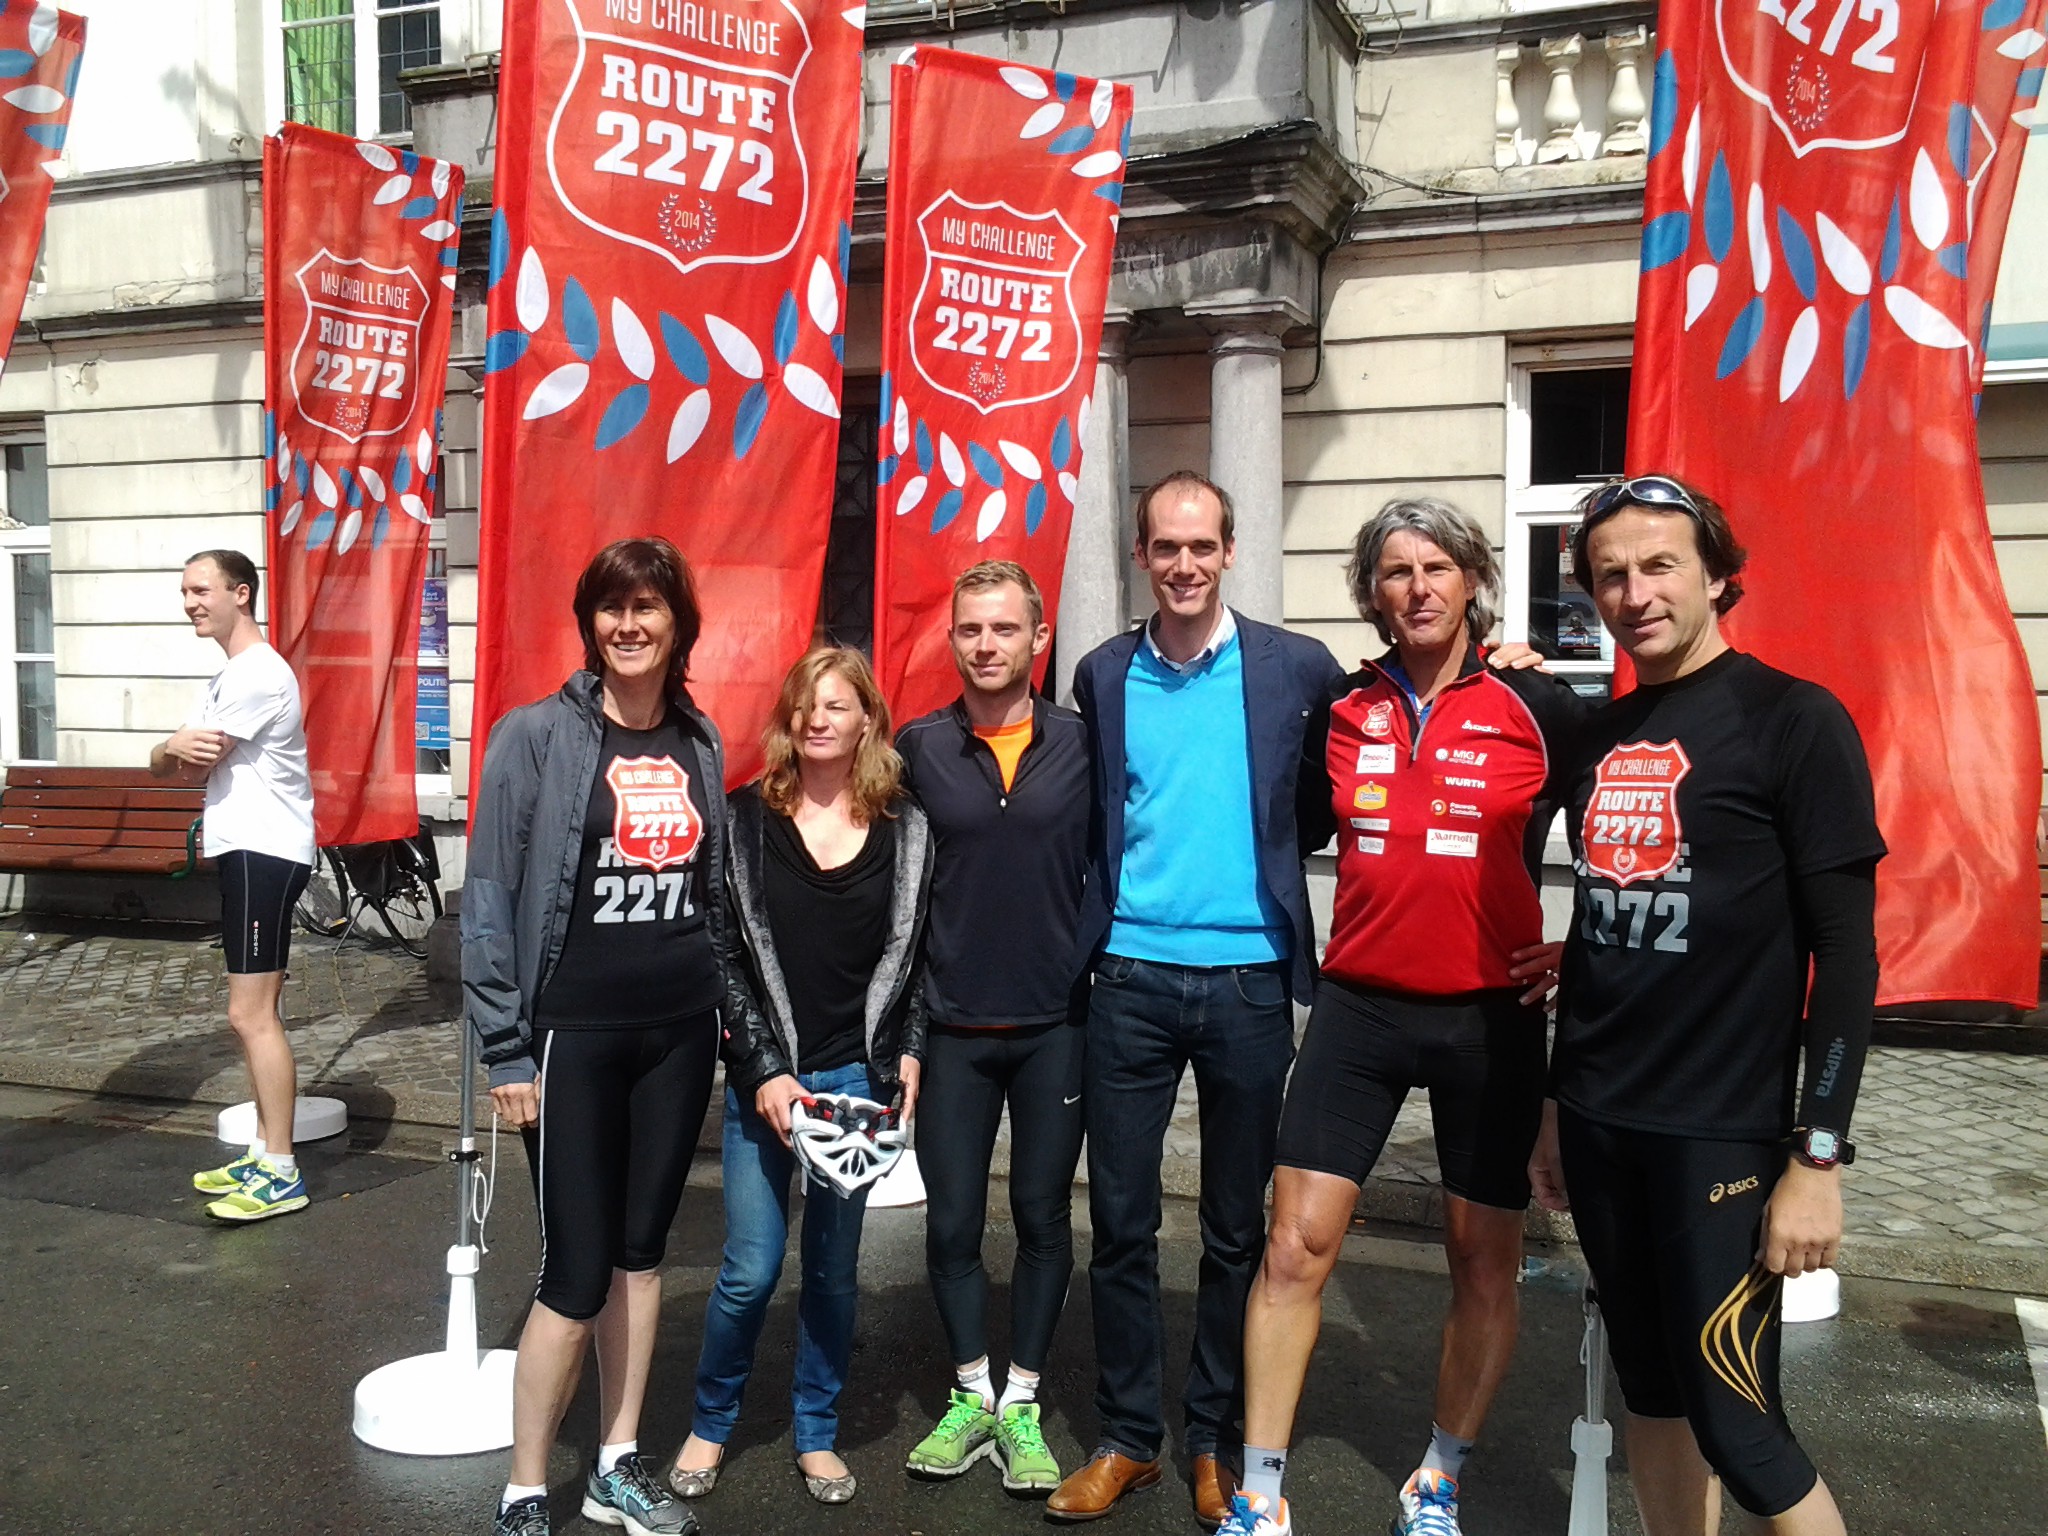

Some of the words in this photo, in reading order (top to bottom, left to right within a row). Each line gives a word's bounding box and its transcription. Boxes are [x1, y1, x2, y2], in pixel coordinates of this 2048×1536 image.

[606, 0, 642, 24] MY
[651, 0, 780, 56] CHALLENGE
[601, 54, 776, 134] ROUTE
[1795, 76, 1816, 104] 2014
[593, 110, 774, 206] 2272
[674, 210, 700, 230] 2014
[942, 217, 966, 246] MY
[971, 222, 1056, 261] CHALLENGE
[321, 271, 340, 296] MY
[341, 276, 411, 310] CHALLENGE
[940, 267, 1052, 314] ROUTE
[318, 316, 408, 357] ROUTE
[932, 305, 1052, 362] 2272
[311, 350, 405, 400] 2272
[978, 371, 996, 385] 2014
[345, 406, 362, 418] 2014
[1621, 759, 1672, 776] CHALLENGE
[624, 795, 684, 812] ROUTE
[1597, 790, 1665, 813] ROUTE
[629, 813, 689, 839] 2272
[1592, 814, 1662, 846] 2272
[1579, 888, 1690, 953] 272
[1726, 1175, 1759, 1196] asics
